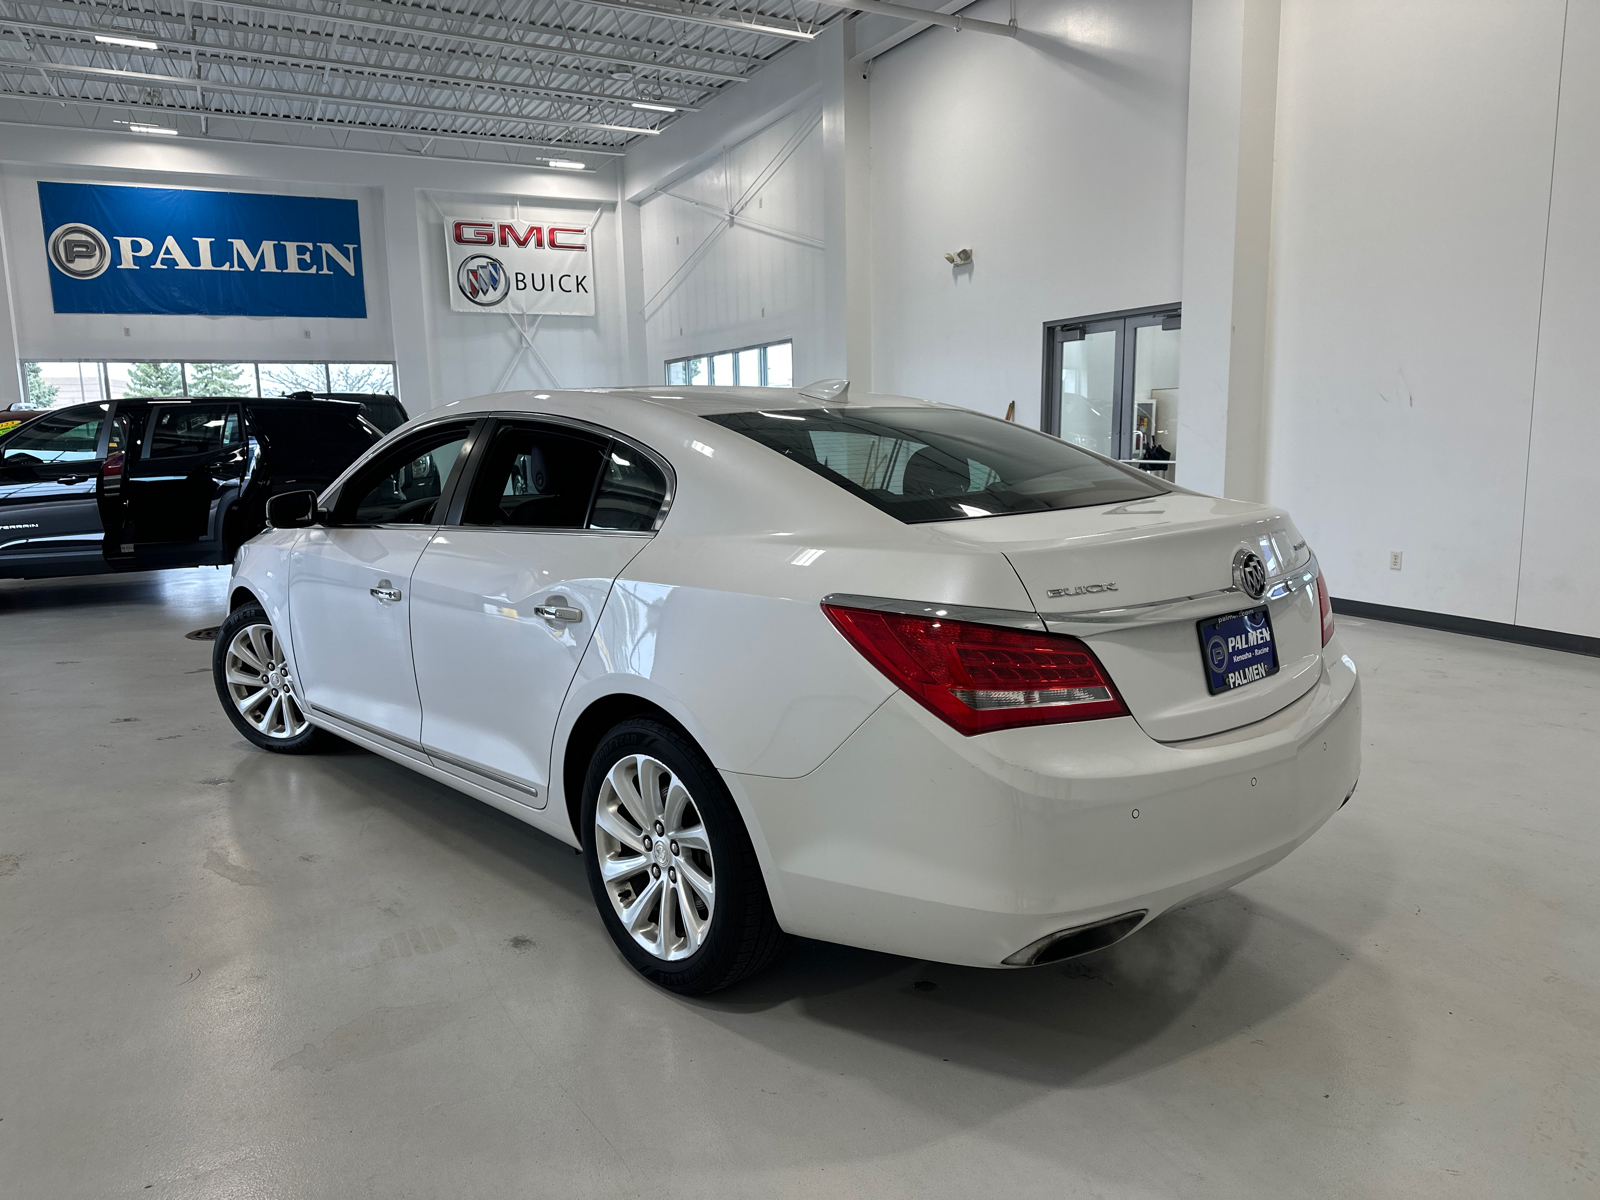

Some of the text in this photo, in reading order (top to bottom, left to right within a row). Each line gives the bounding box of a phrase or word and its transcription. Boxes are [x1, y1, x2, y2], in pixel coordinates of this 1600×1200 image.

[453, 220, 588, 252] GMC
[113, 235, 359, 277] PALMEN
[515, 272, 589, 294] BUICK
[1046, 582, 1119, 599] BUICK
[1228, 627, 1271, 653] PALMEN
[1233, 652, 1253, 663] Kenosha
[1254, 646, 1270, 657] Racine
[1228, 663, 1267, 689] PALMEN
[592, 734, 638, 773] GOODYEAR
